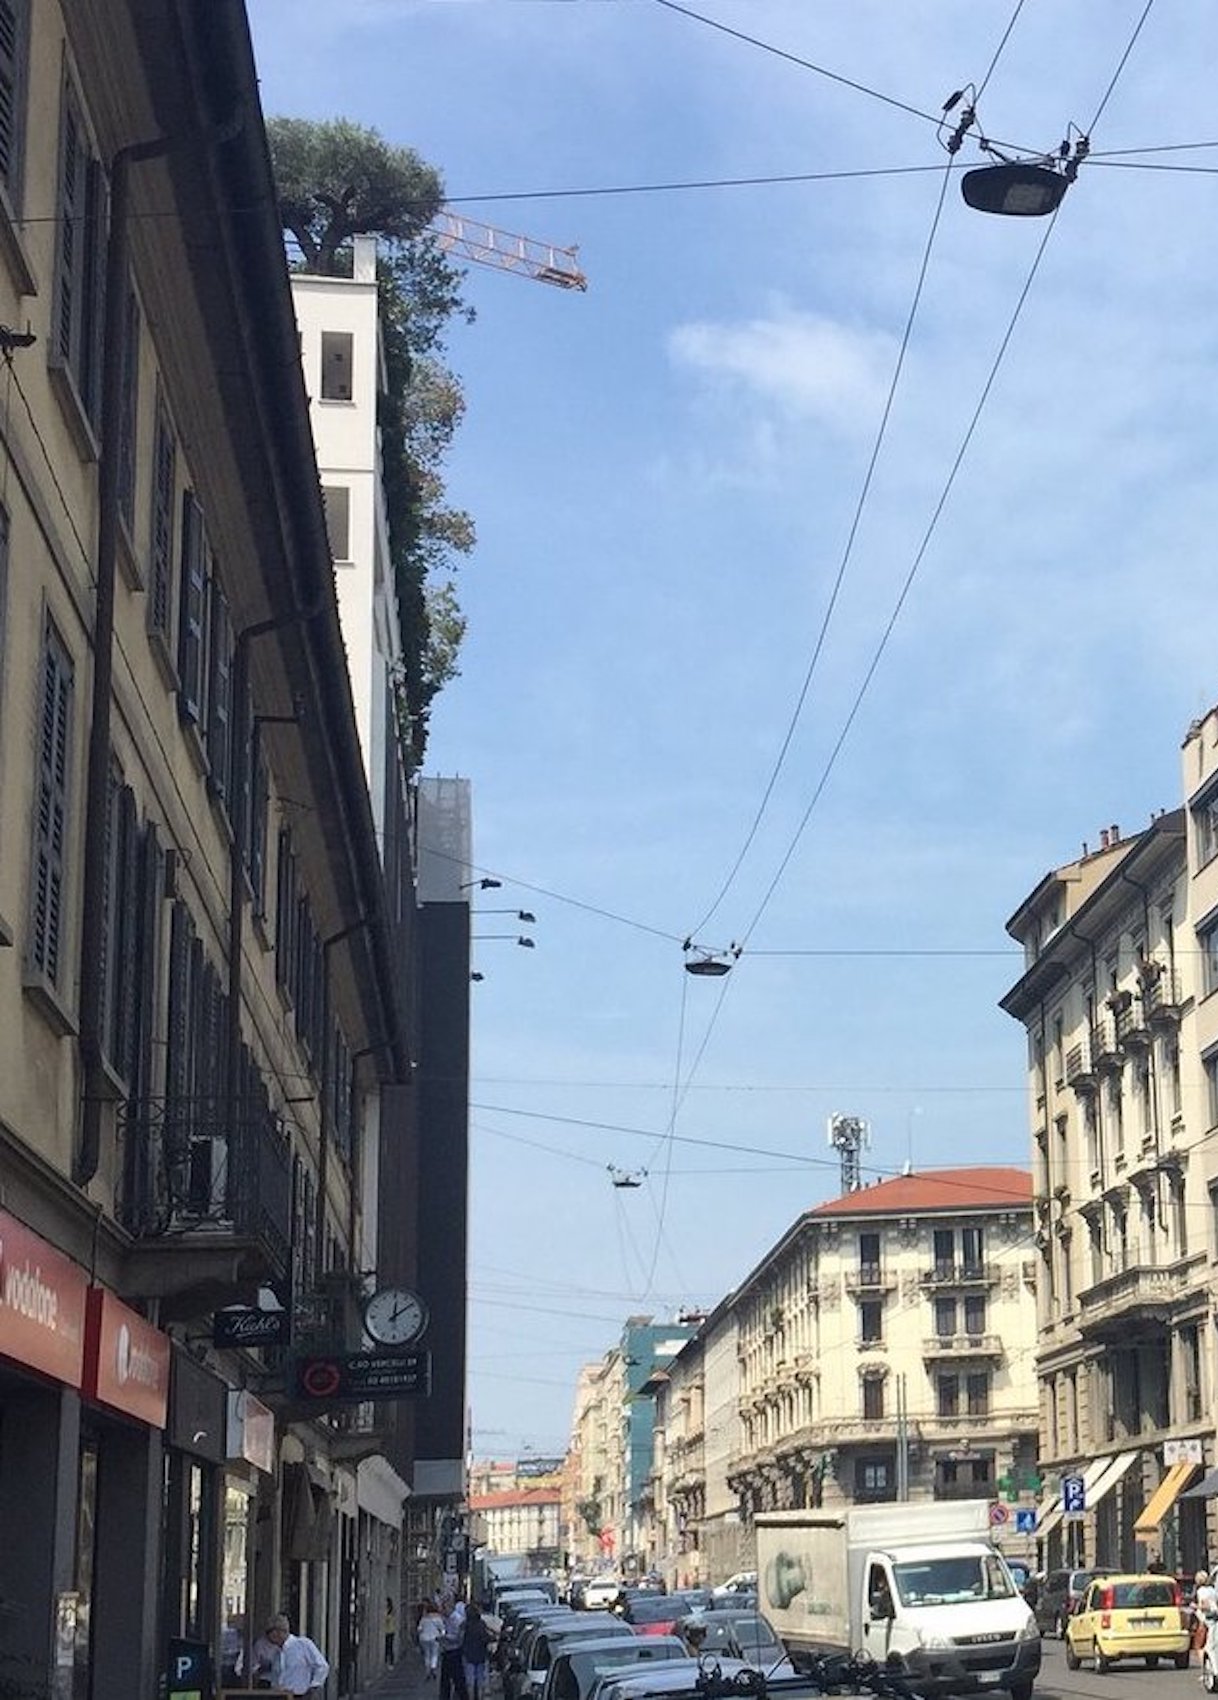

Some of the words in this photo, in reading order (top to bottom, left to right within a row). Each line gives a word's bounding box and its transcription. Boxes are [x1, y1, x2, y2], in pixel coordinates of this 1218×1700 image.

[5, 1259, 58, 1331] vodafone
[227, 1314, 281, 1334] Kiehl's
[1068, 1483, 1079, 1499] P
[176, 1656, 192, 1680] P
